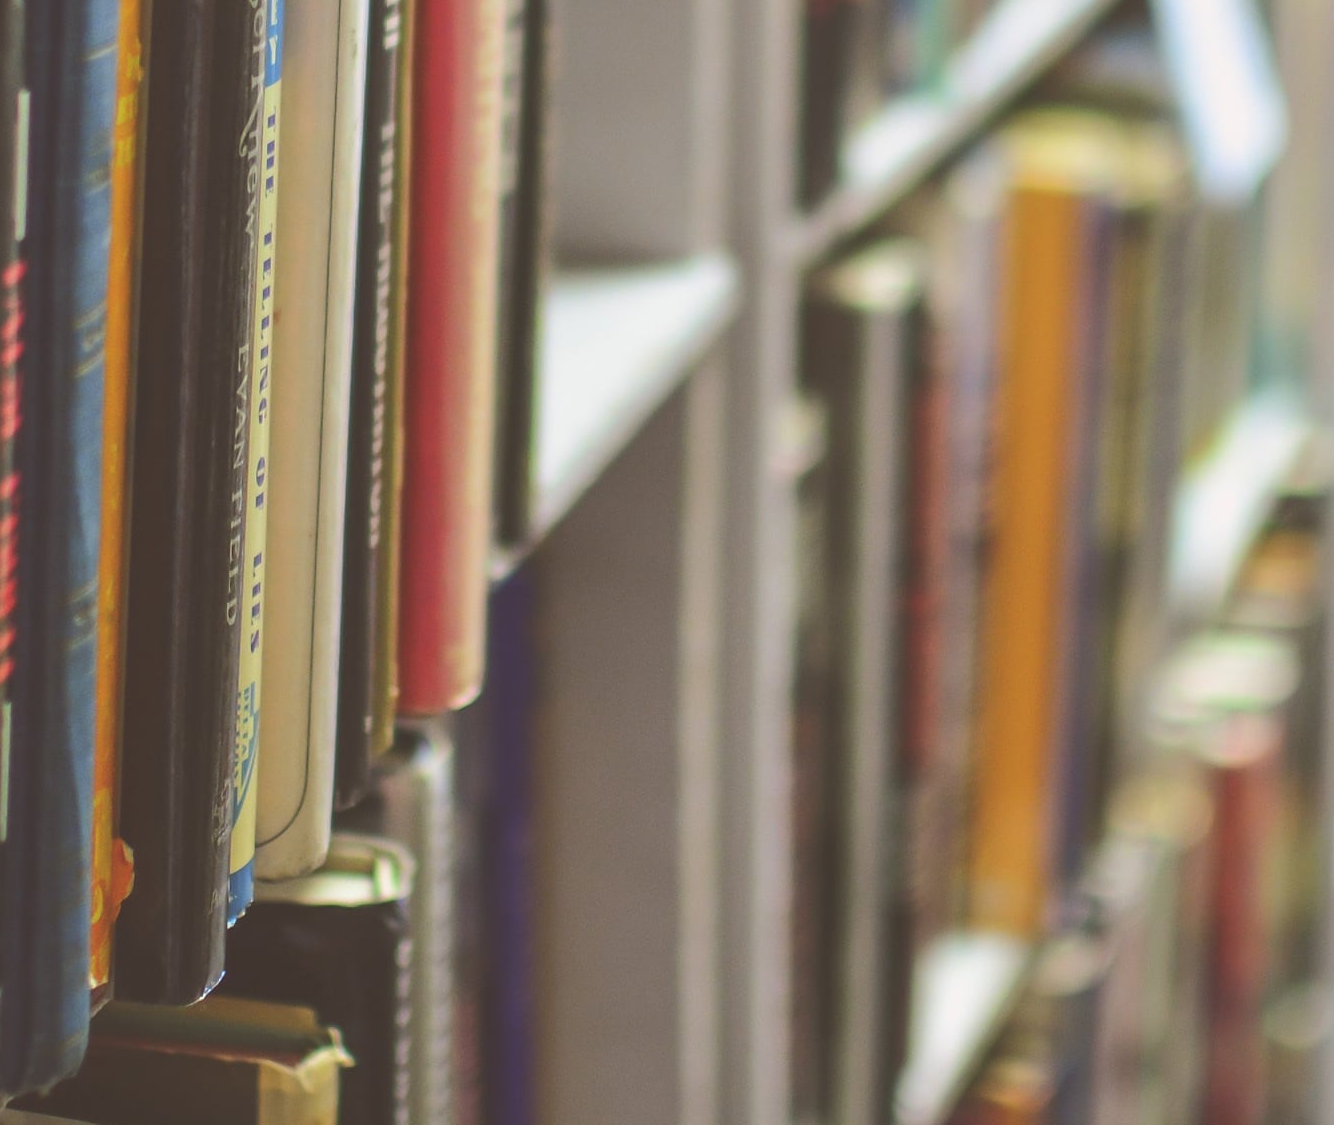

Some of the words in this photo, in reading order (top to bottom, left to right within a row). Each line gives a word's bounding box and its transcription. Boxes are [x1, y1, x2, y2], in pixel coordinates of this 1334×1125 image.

[239, 74, 264, 248] Knew
[265, 106, 276, 197] THE
[258, 228, 273, 424] TELLING
[233, 343, 250, 469] EVAN
[255, 456, 266, 510] OF
[226, 491, 243, 627] FIELD
[251, 553, 263, 655] LIES
